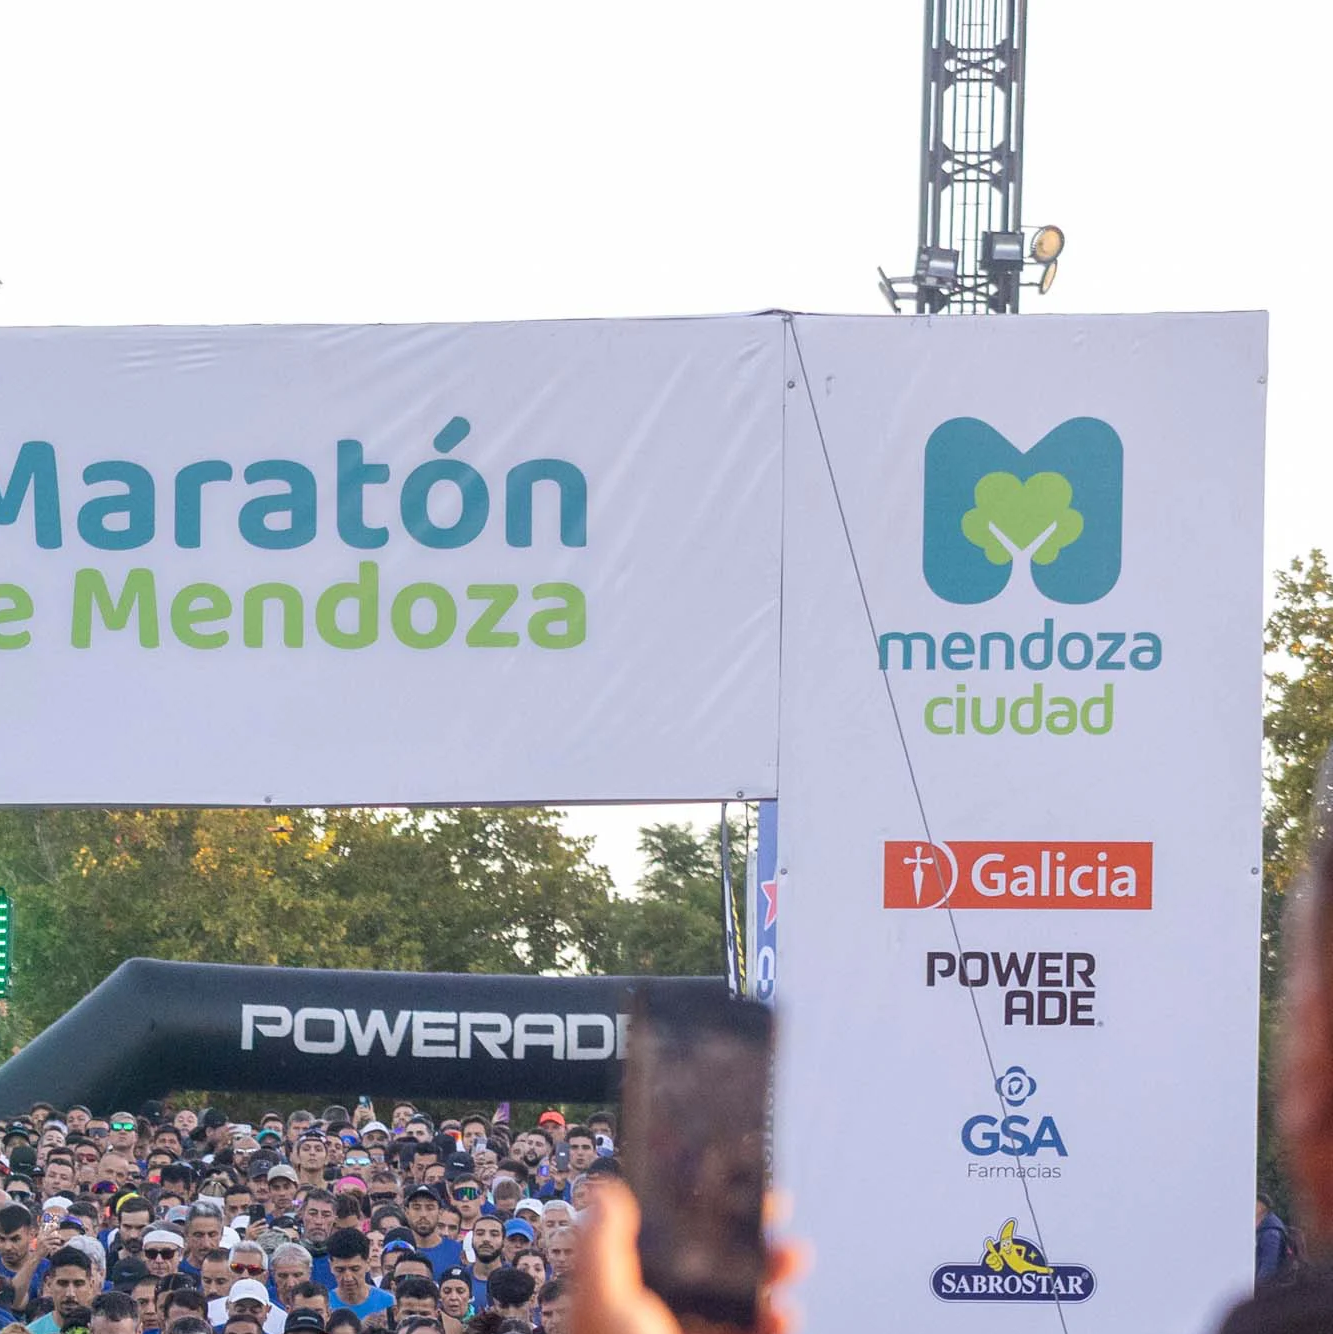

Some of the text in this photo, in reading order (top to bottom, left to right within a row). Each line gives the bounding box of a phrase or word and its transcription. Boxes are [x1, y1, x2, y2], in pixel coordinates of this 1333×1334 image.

[70, 561, 588, 650] Mendoza
[878, 618, 1162, 670] mendoza
[924, 683, 1114, 735] ciudad
[971, 851, 1137, 897] Galicia
[926, 951, 1097, 988] POWER
[1004, 990, 1096, 1026] ADE
[961, 1114, 1069, 1157] GSA
[967, 1162, 1062, 1179] Farmacias
